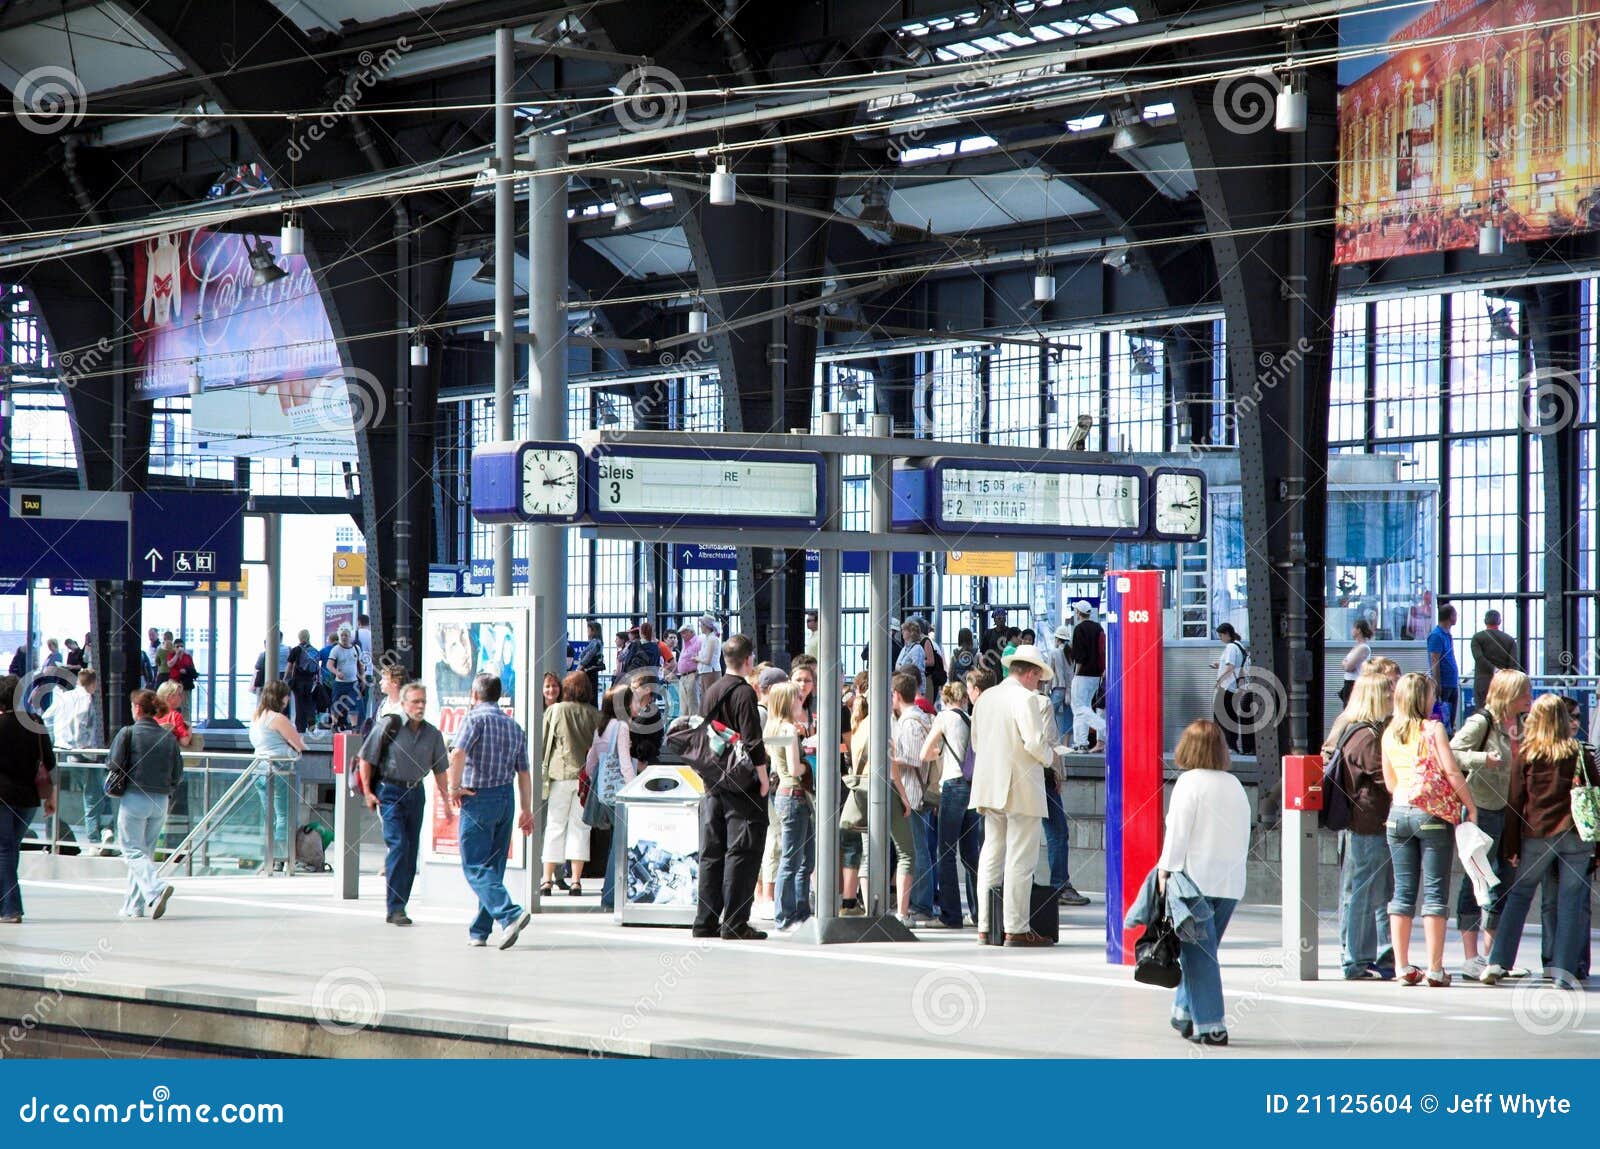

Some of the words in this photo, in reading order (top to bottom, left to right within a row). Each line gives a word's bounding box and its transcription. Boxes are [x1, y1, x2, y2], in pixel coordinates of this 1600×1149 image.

[599, 465, 634, 479] Gleis
[724, 472, 739, 482] RE
[610, 481, 621, 504] 3
[23, 501, 40, 509] TAXI
[473, 564, 491, 577] Berlin
[1128, 610, 1149, 623] SOS
